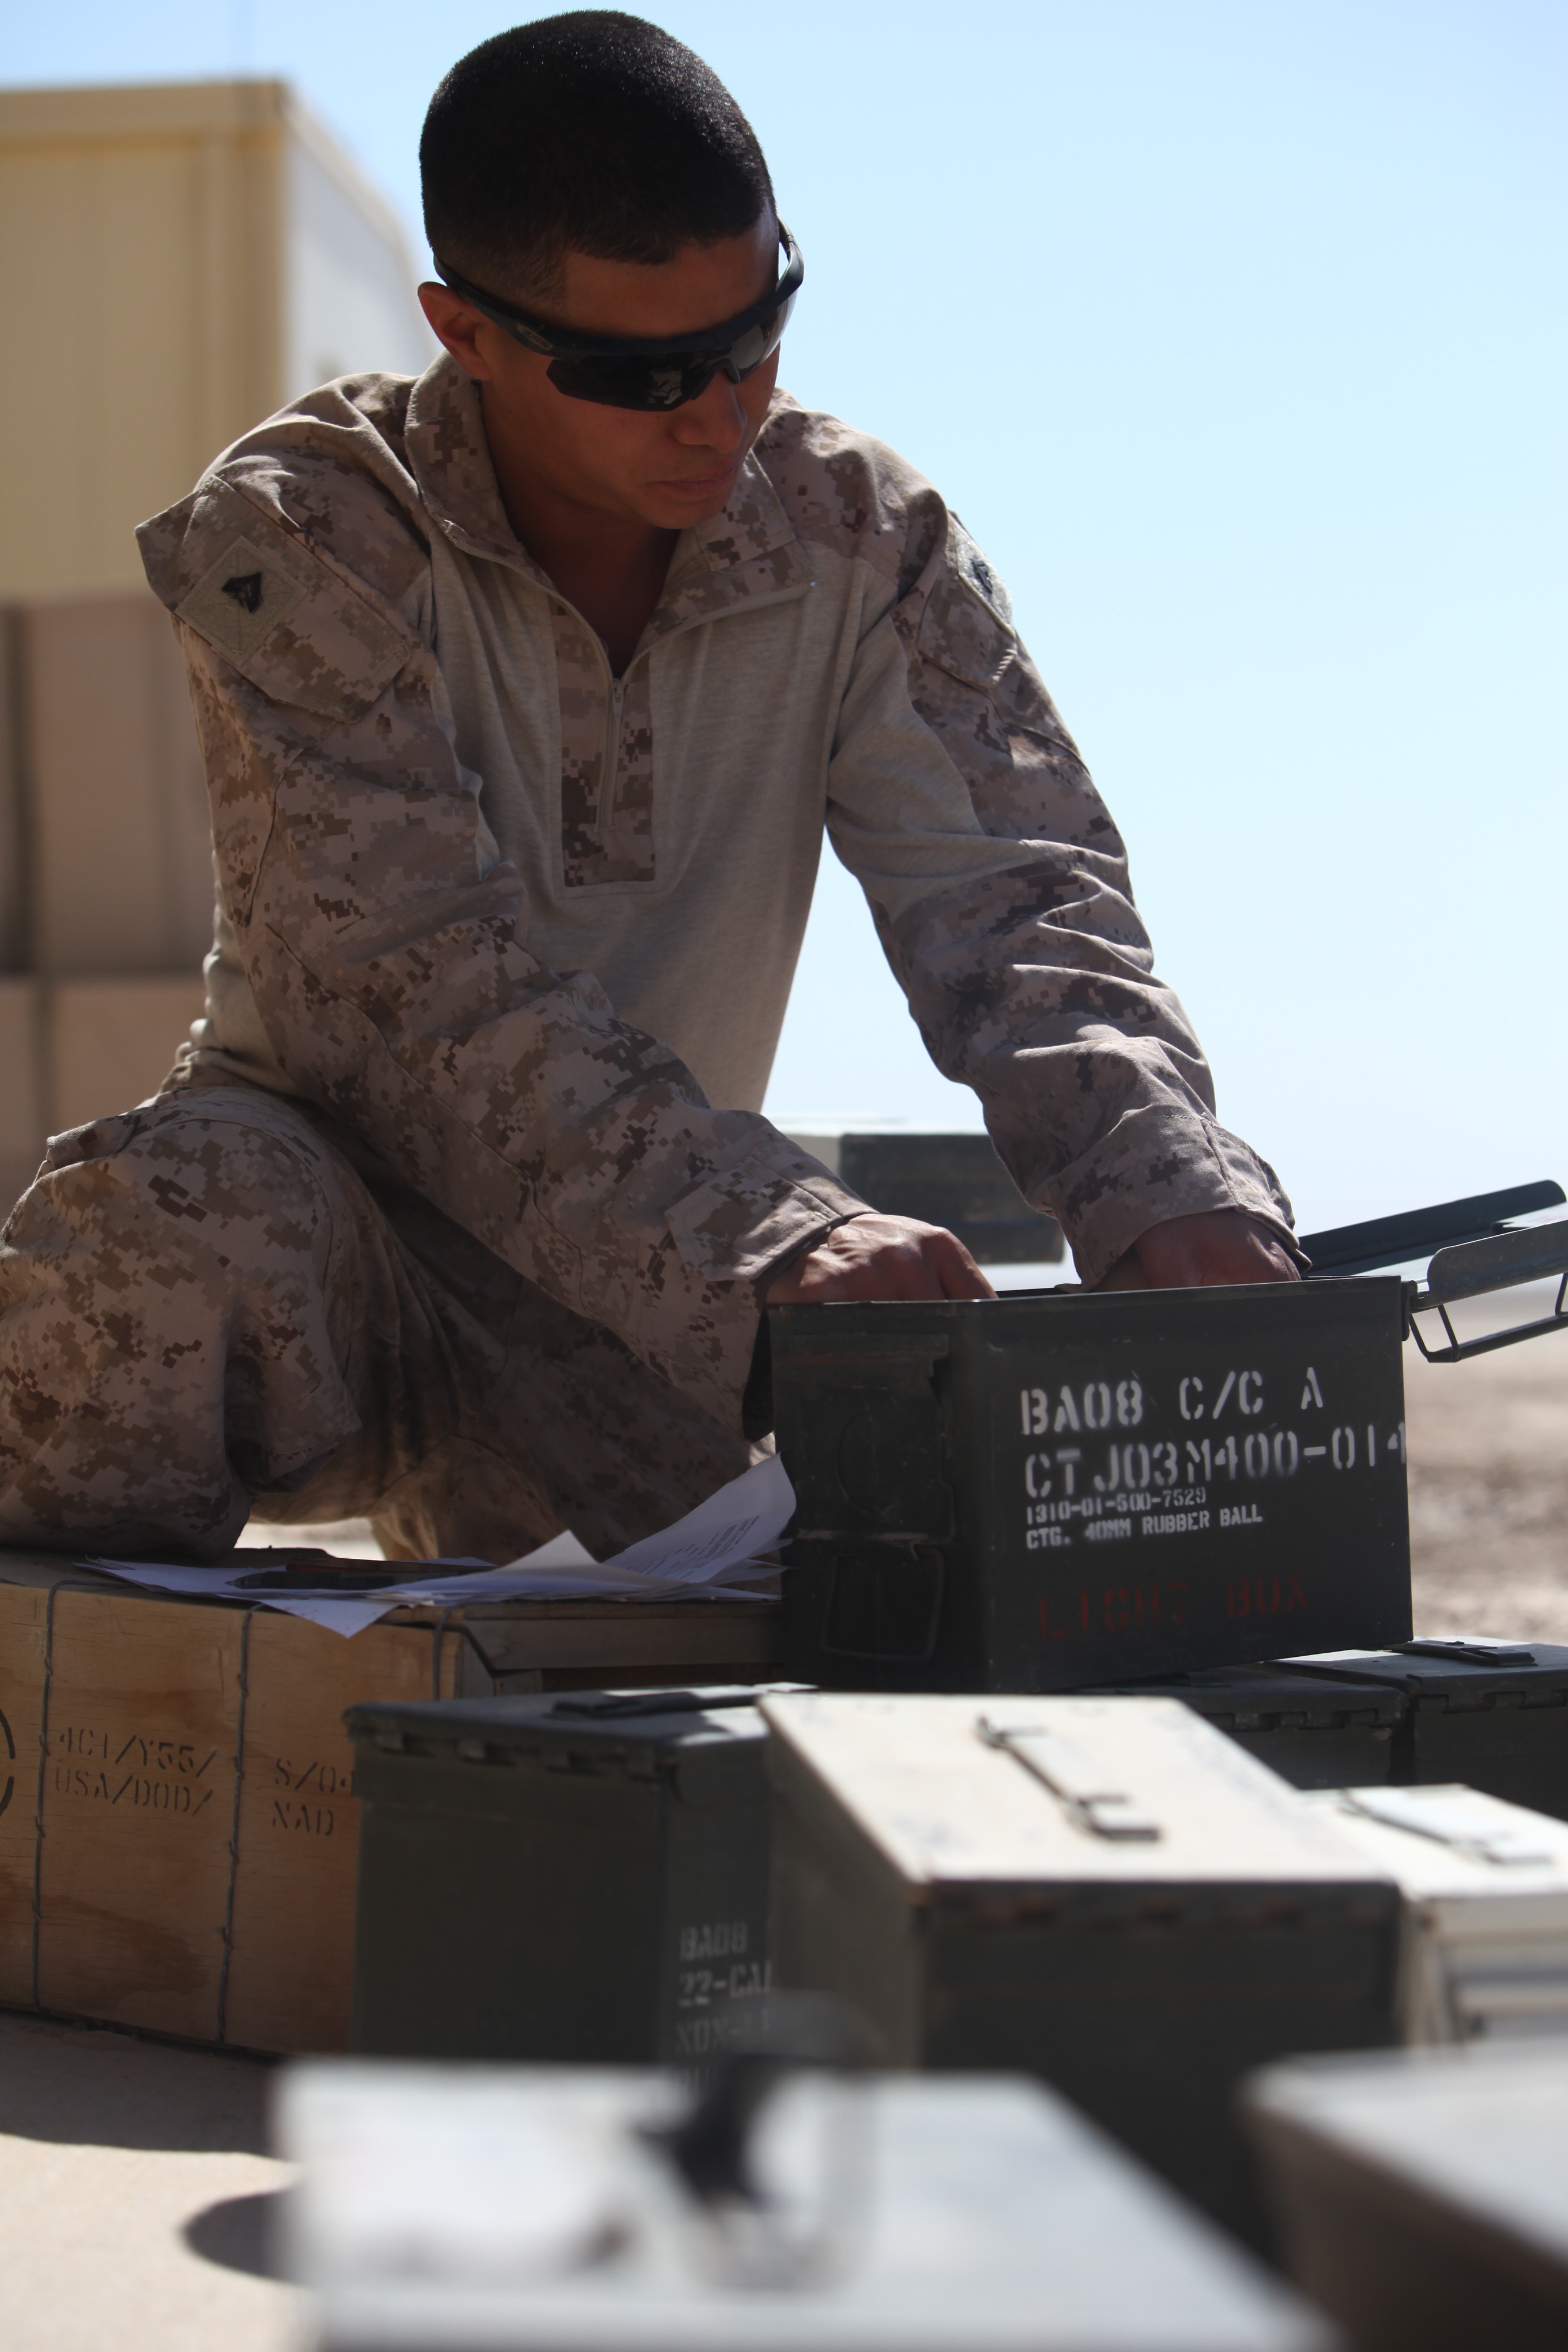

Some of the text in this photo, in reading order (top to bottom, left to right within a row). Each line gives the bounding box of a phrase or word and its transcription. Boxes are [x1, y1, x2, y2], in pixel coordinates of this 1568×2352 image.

[1020, 1367, 1323, 1434] BA08 C/C A
[1026, 1504, 1262, 1550] CTG. 40MM RUBBER BALL
[1039, 1570, 1307, 1639] LIGHT BOX
